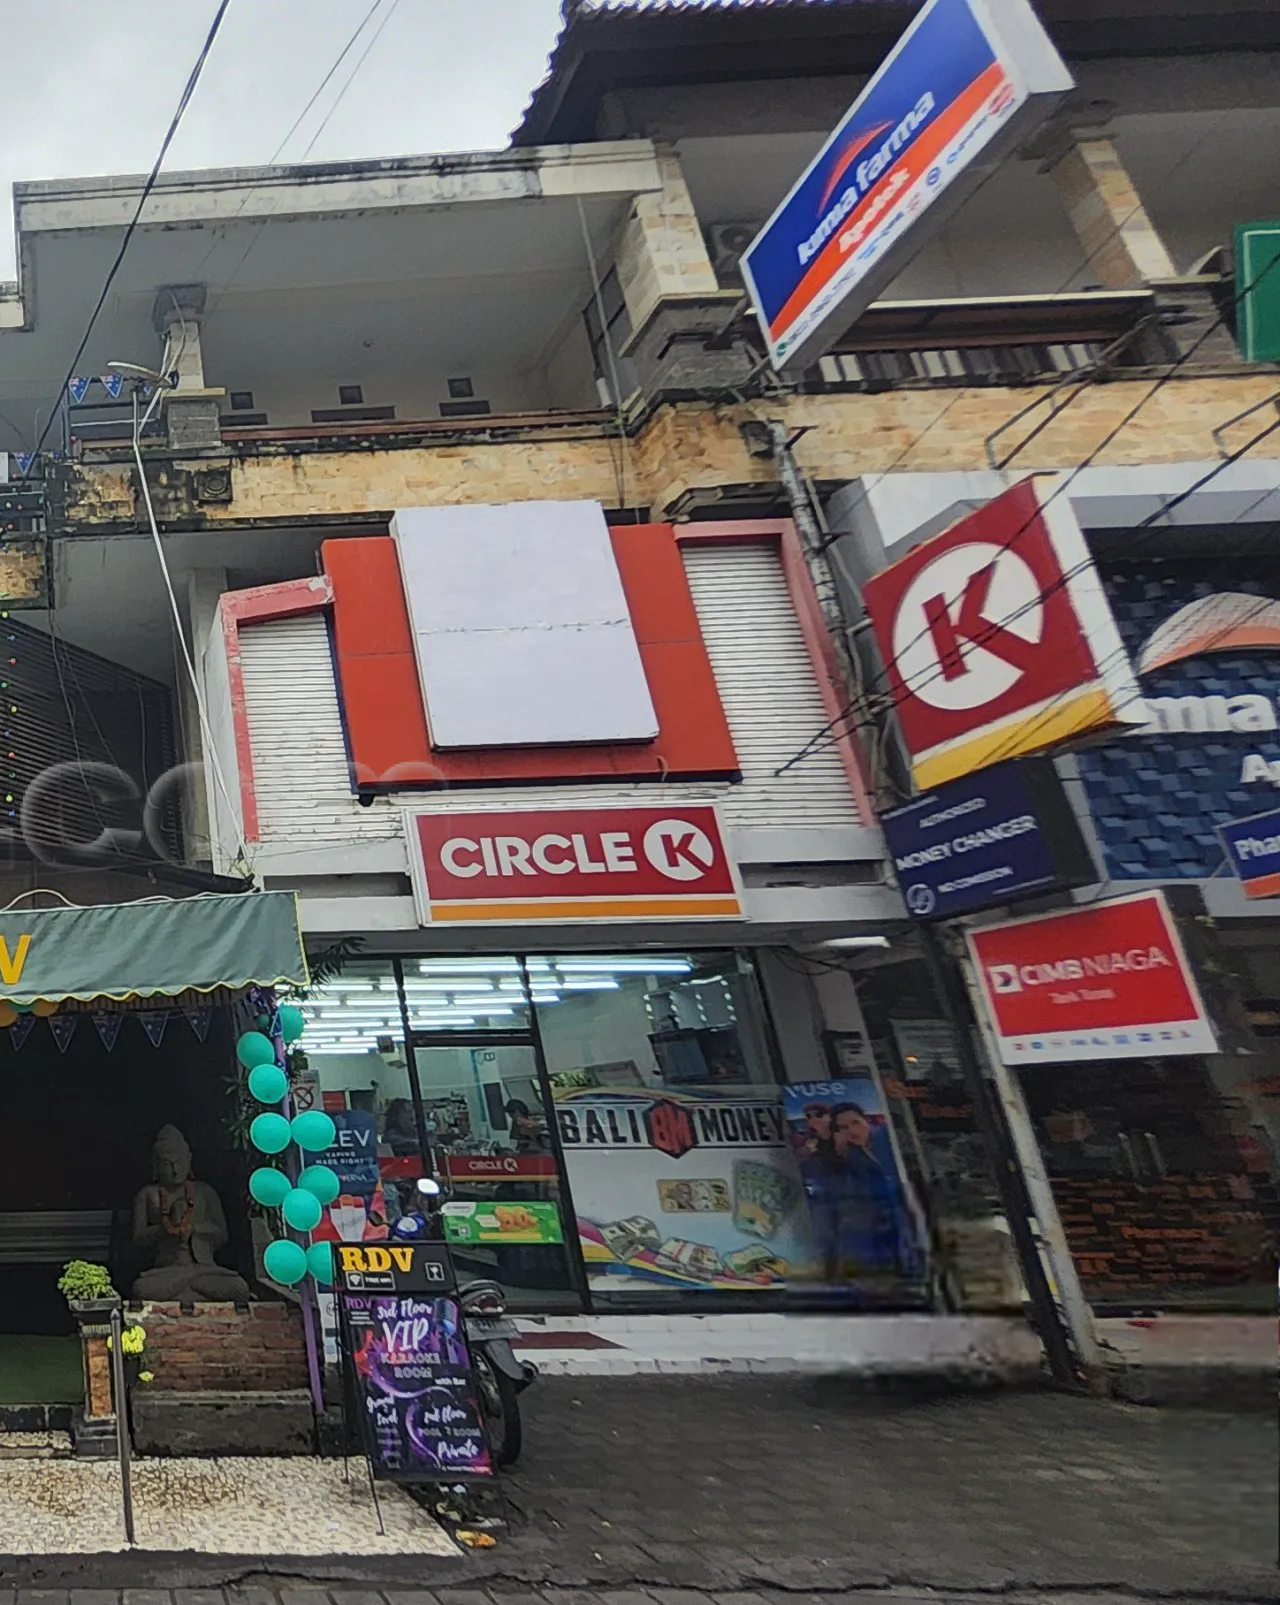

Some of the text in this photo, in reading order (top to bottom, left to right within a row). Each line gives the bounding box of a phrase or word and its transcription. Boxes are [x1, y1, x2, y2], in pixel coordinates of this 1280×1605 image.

[856, 91, 936, 191] farma
[915, 553, 1042, 687] K
[440, 824, 715, 878] CIRCLE K
[895, 815, 1039, 871] MONEY CHANGER
[1021, 946, 1172, 986] CIMB NIAGA
[558, 1108, 641, 1144] BALI
[696, 1105, 786, 1143] MONEY
[468, 1160, 502, 1171] CIRCLE
[339, 1246, 415, 1272] RDV
[345, 1296, 372, 1309] RDV
[382, 1317, 429, 1352] VIP
[394, 1367, 433, 1379] ROOM
